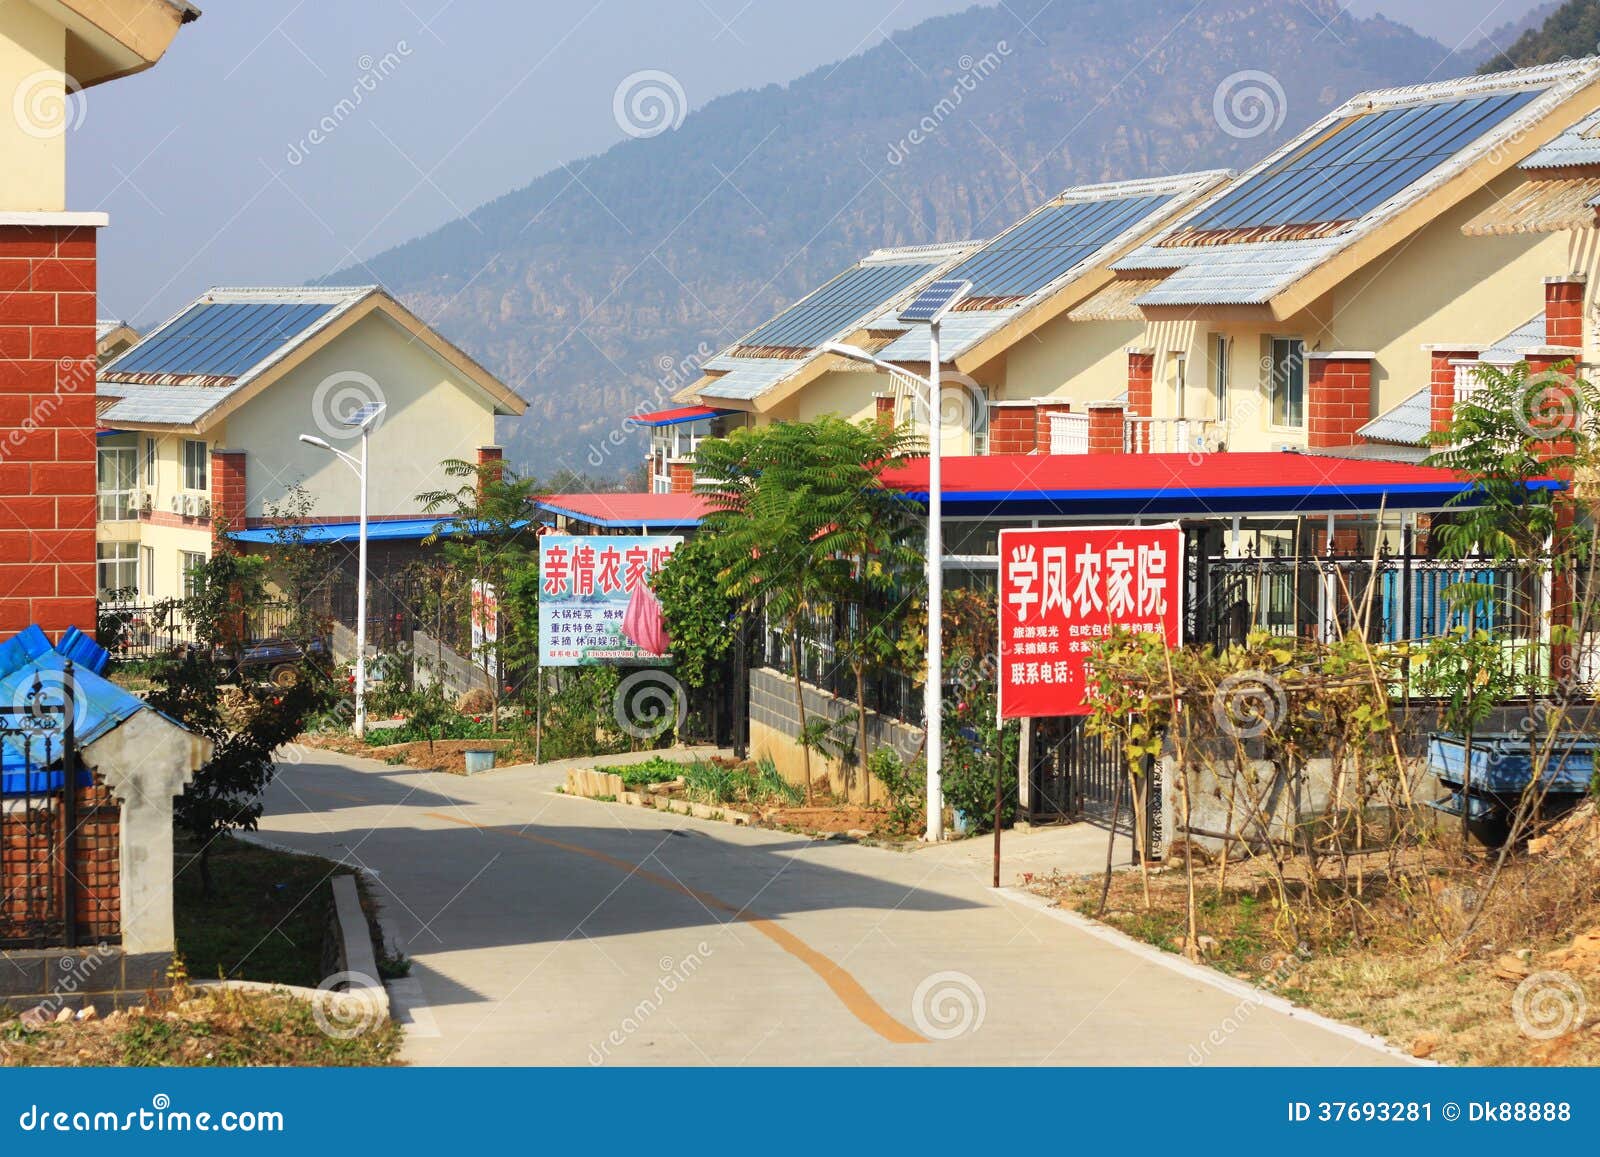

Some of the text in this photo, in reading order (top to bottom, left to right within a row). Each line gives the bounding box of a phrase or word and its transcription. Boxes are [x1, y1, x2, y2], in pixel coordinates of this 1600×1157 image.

[1008, 541, 1167, 622] 学凤农家院
[551, 609, 593, 619] 大锅炖菜
[550, 623, 605, 633] 重庆特色菜
[1013, 626, 1059, 639] 旅游观光
[550, 636, 572, 646] 采摘
[576, 636, 619, 646] 休闲娱乐
[1013, 642, 1059, 655] 采摘娱乐
